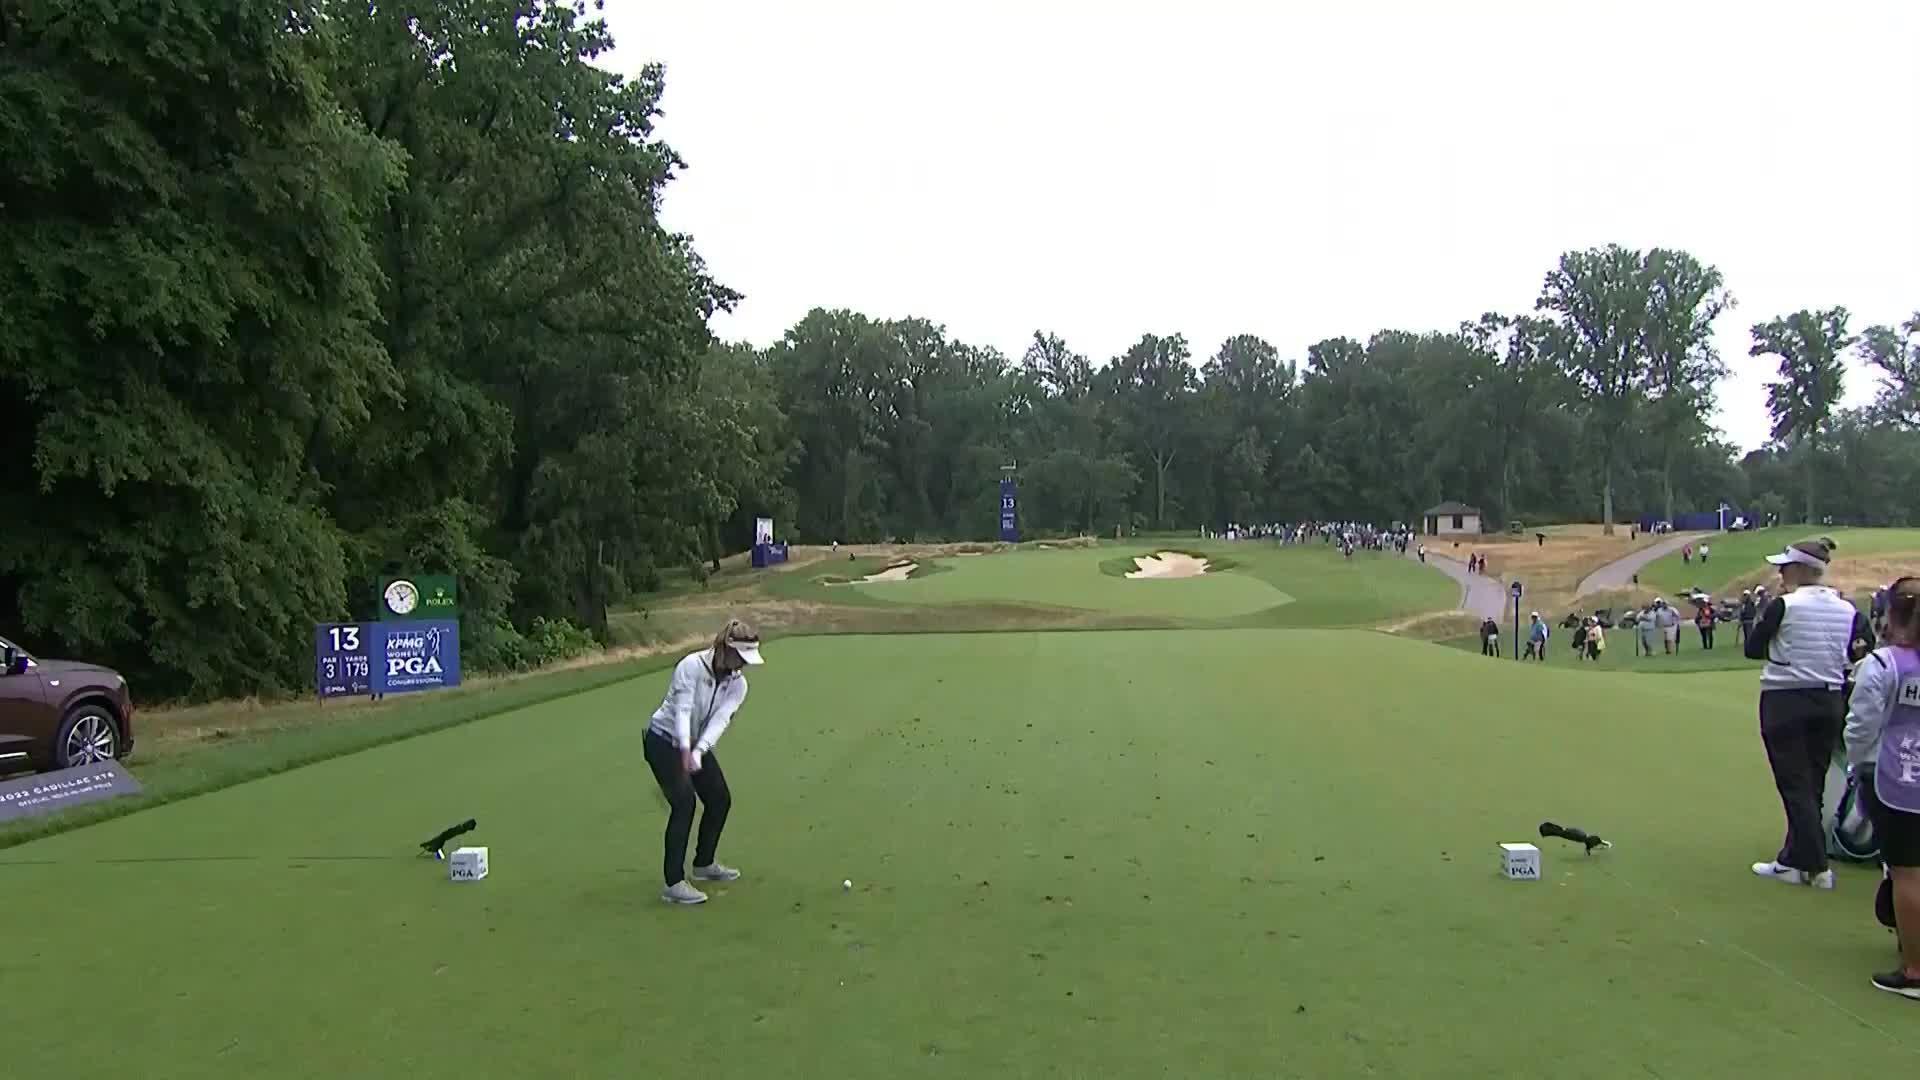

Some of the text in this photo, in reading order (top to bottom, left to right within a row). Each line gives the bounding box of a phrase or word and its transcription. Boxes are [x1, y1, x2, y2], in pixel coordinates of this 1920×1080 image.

[1002, 498, 1015, 509] 13
[426, 598, 455, 606] ROLEX
[329, 626, 360, 651] 13
[386, 638, 424, 650] KPMG
[345, 655, 368, 663] YARDS
[387, 649, 426, 658] WOMEN'S
[326, 664, 335, 678] 3
[346, 663, 369, 677] 179
[386, 656, 443, 676] PGA
[33, 777, 91, 794] CADILLAC
[452, 869, 474, 878] PGA
[1511, 866, 1536, 876] PGA
